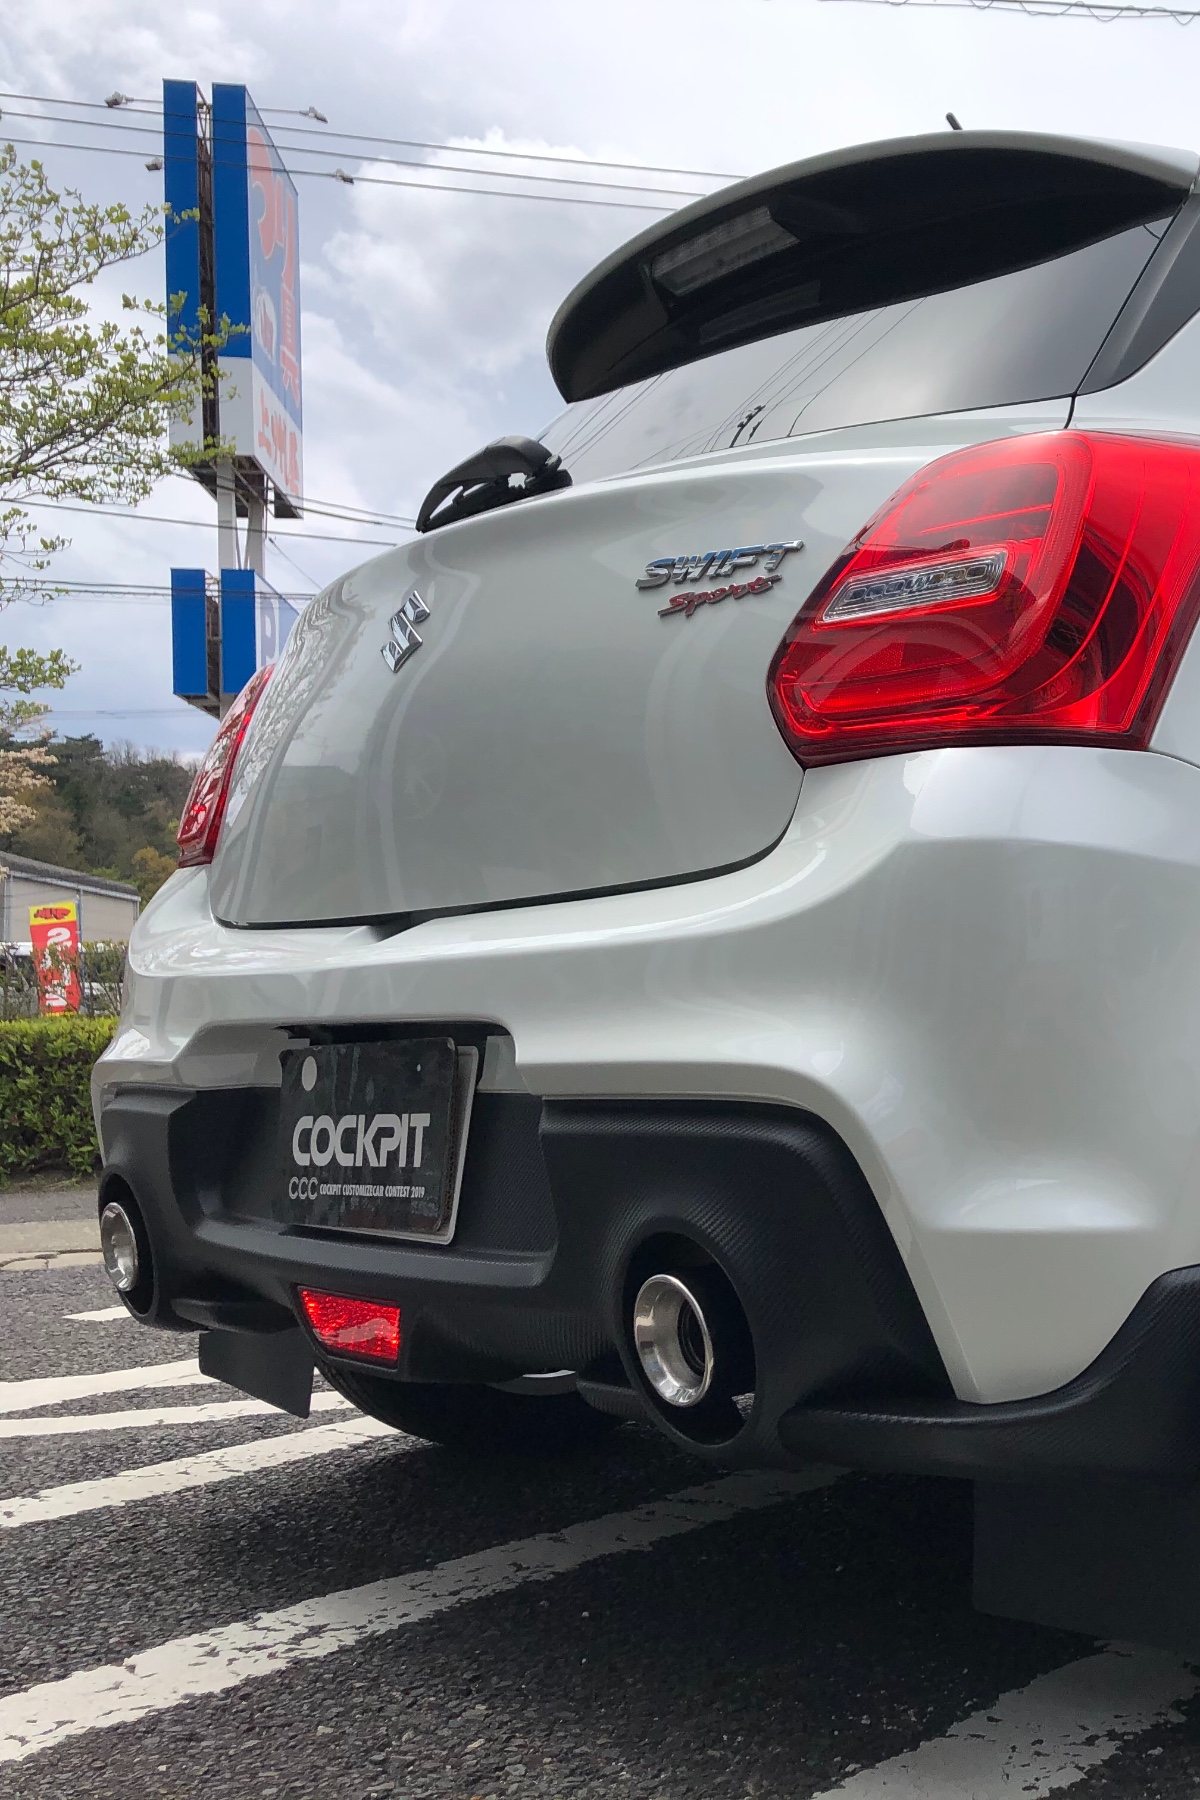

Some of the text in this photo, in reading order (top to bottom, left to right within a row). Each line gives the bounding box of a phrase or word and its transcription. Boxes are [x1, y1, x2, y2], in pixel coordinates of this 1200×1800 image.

[635, 539, 805, 590] SWIFT
[657, 573, 783, 619] Sport
[292, 1112, 431, 1168] COCKPIT
[288, 1176, 318, 1200] CCC
[319, 1183, 342, 1196] COCKPIT
[384, 1185, 411, 1198] CONTEST
[410, 1186, 425, 1198] 2019
